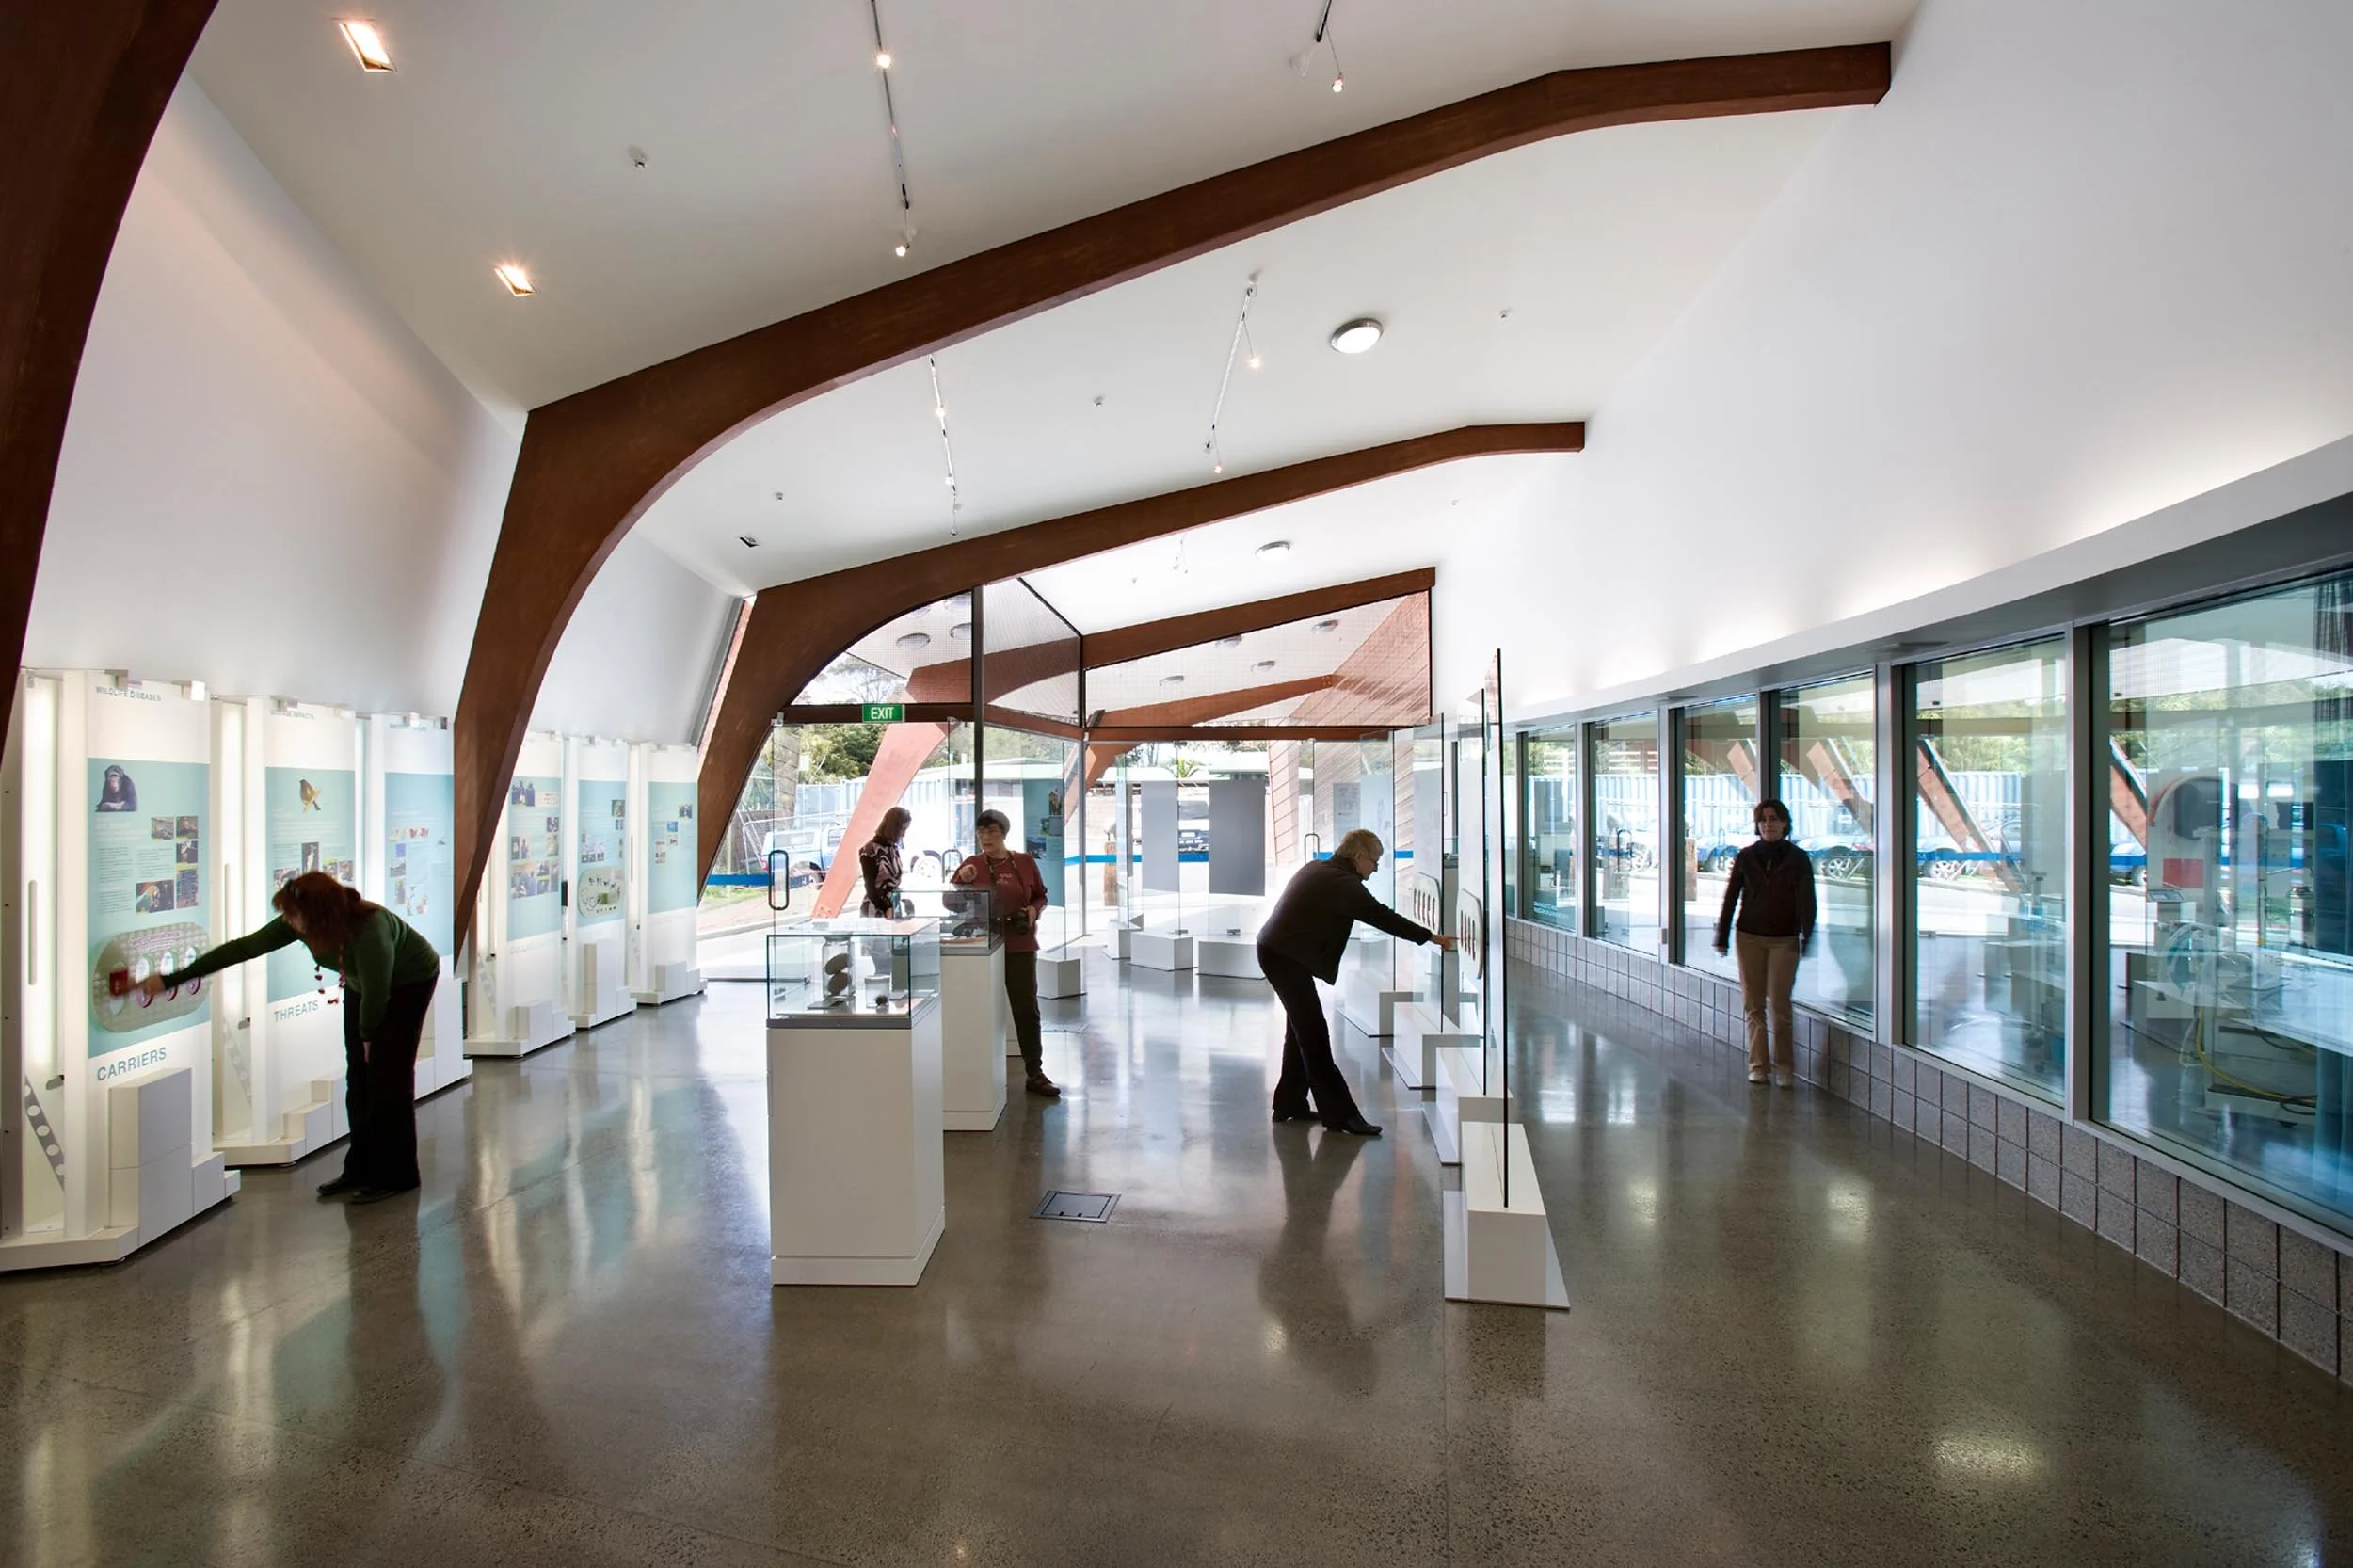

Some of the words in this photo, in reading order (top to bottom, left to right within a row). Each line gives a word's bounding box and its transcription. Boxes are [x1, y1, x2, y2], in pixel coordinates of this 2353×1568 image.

[130, 690, 161, 702] DISEASES
[871, 707, 894, 720] EXIT
[274, 1000, 318, 1023] THREATS
[97, 1047, 167, 1080] CARRIERS
